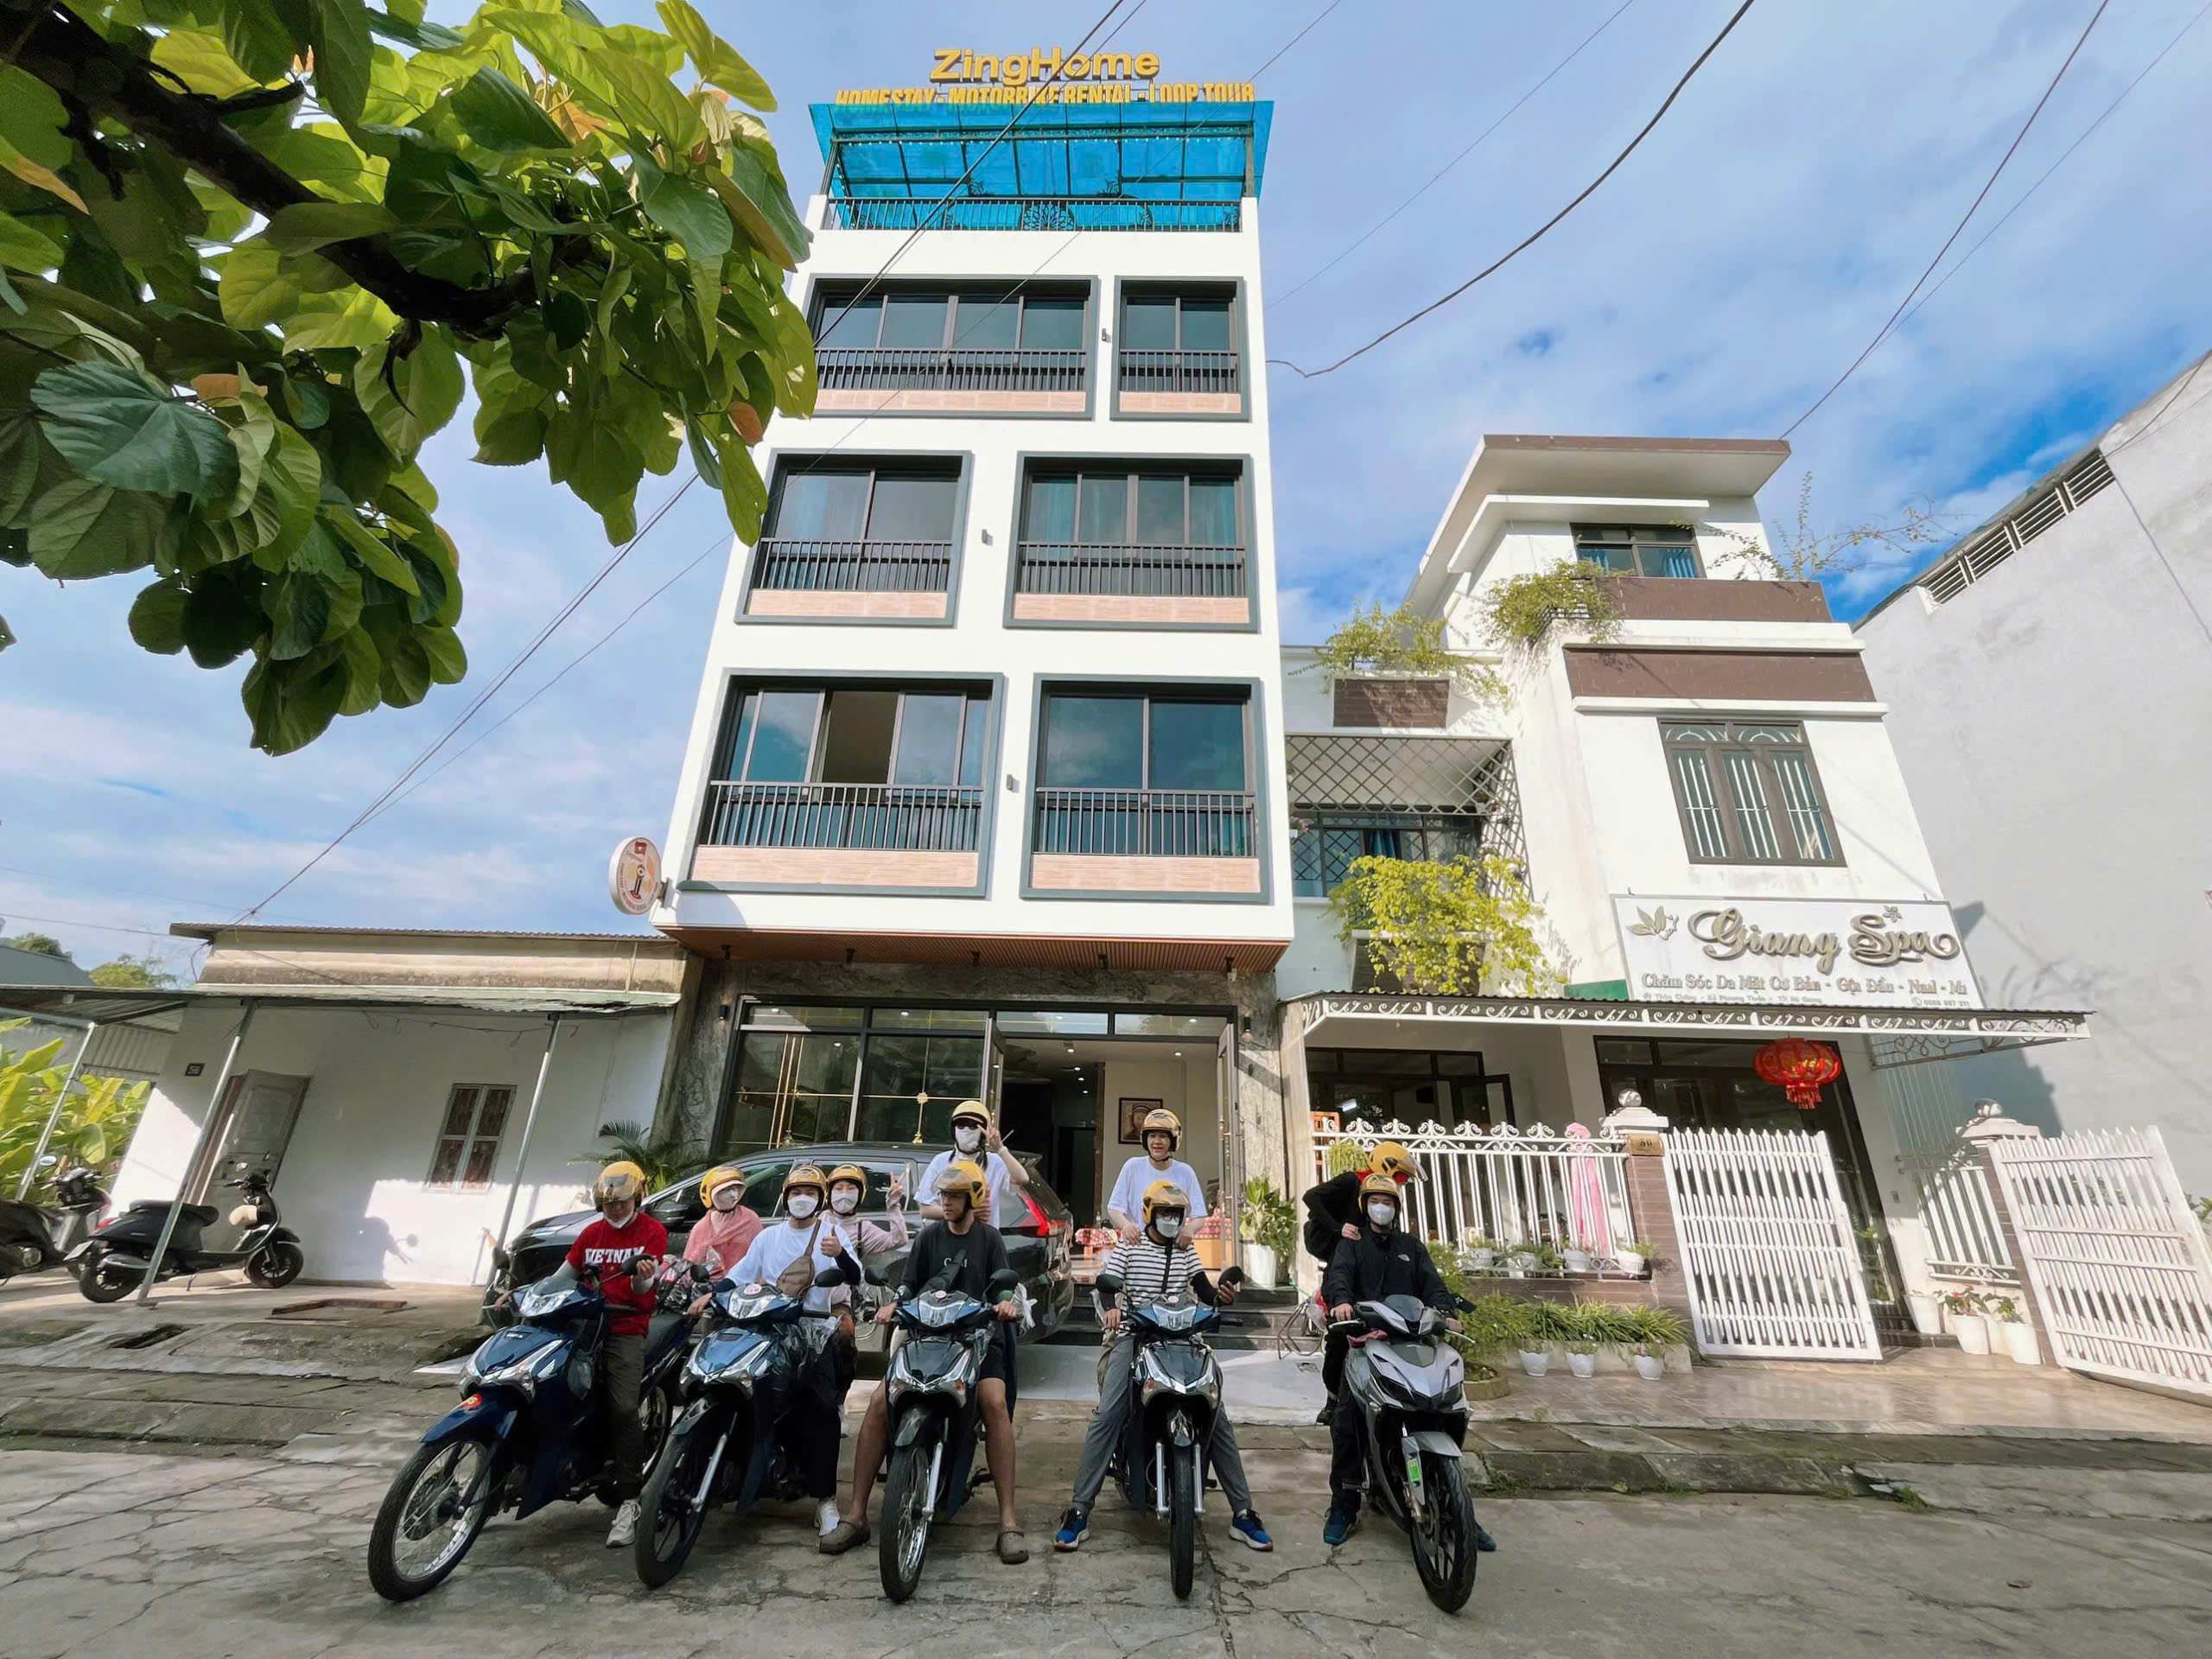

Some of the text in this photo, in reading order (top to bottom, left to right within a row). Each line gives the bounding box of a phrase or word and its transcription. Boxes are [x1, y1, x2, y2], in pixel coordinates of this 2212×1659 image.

[930, 47, 1160, 86] ZingHome
[836, 88, 937, 105] HOMESTAY
[1202, 83, 1255, 103] TOUR
[1688, 907, 1961, 976] Giang Spa
[1642, 973, 1683, 989] Chăm
[1685, 974, 1713, 990] Sóc
[1715, 975, 1736, 990] Da
